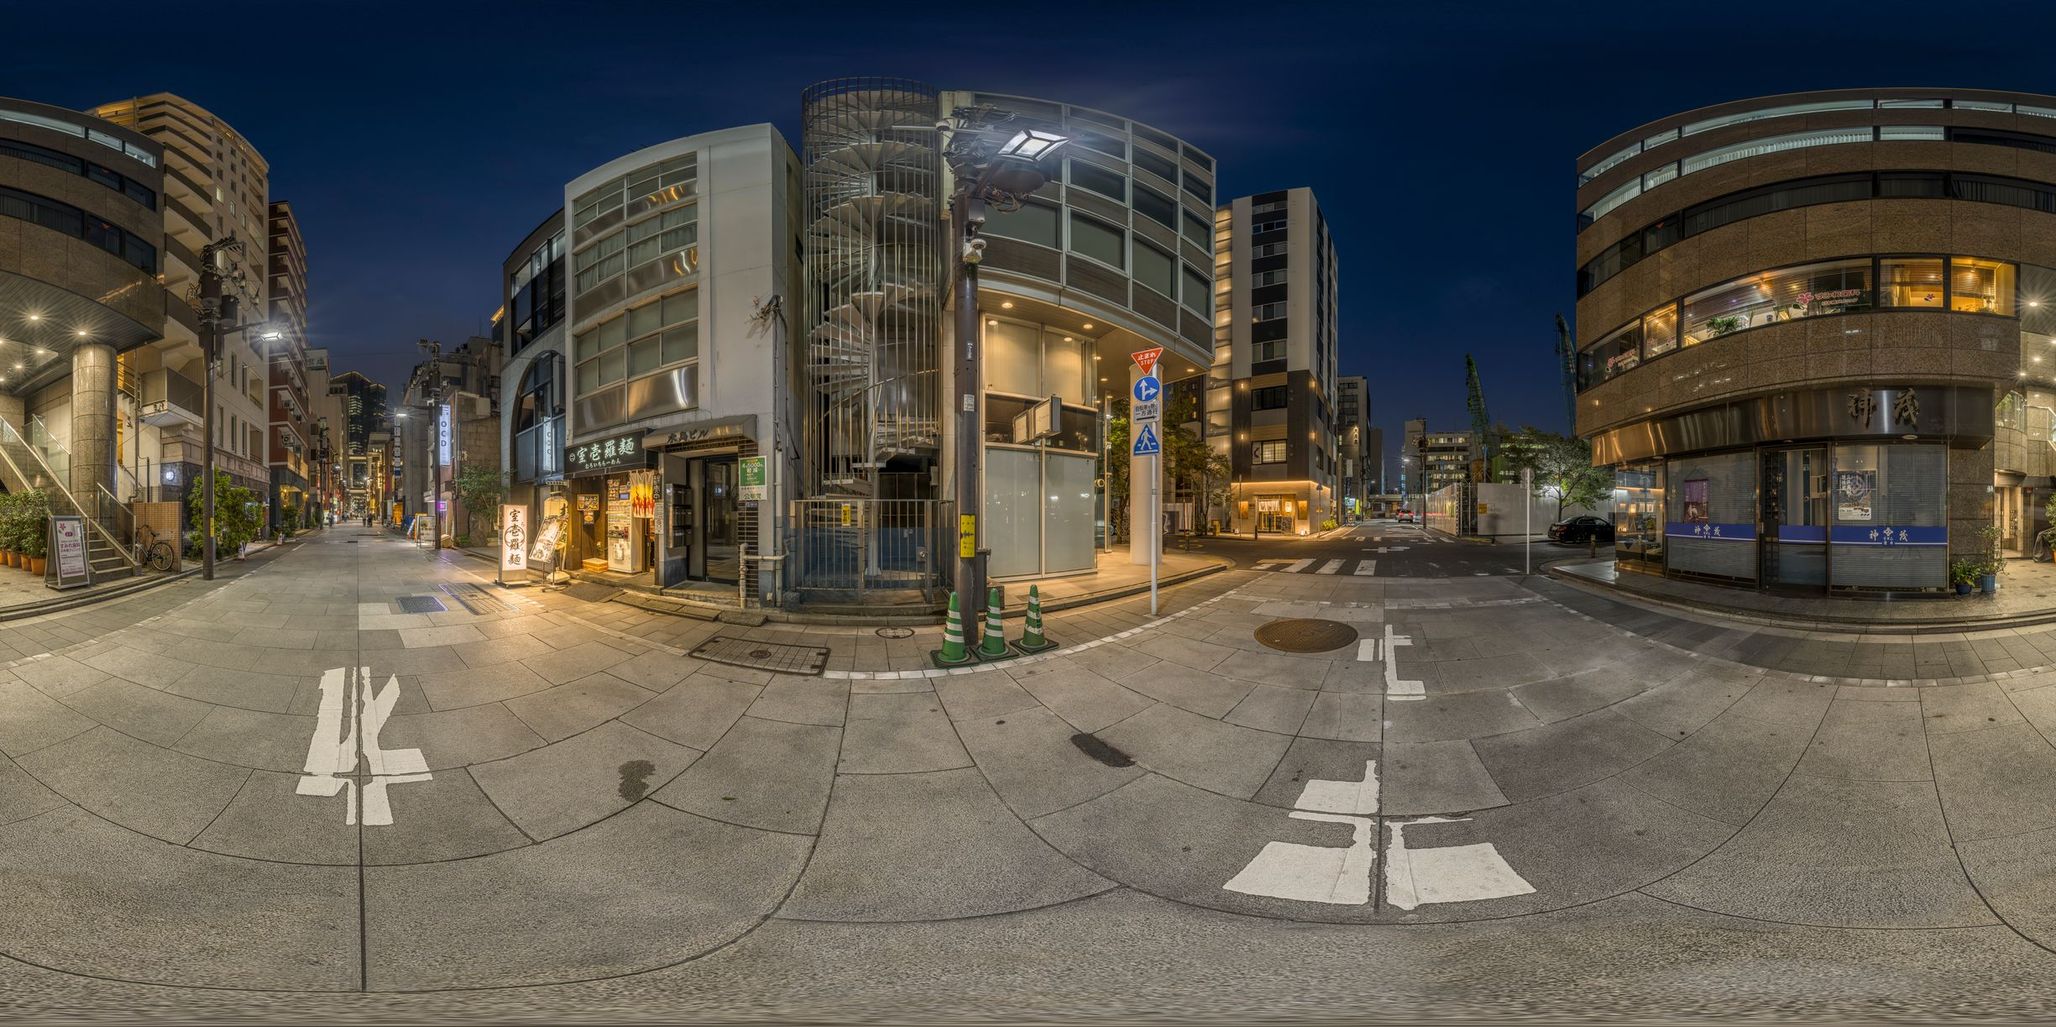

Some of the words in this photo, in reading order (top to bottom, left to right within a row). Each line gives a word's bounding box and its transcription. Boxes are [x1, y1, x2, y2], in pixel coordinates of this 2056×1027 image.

[576, 437, 635, 464] 室壱羅麺
[507, 509, 521, 566] 室壱羅麺
